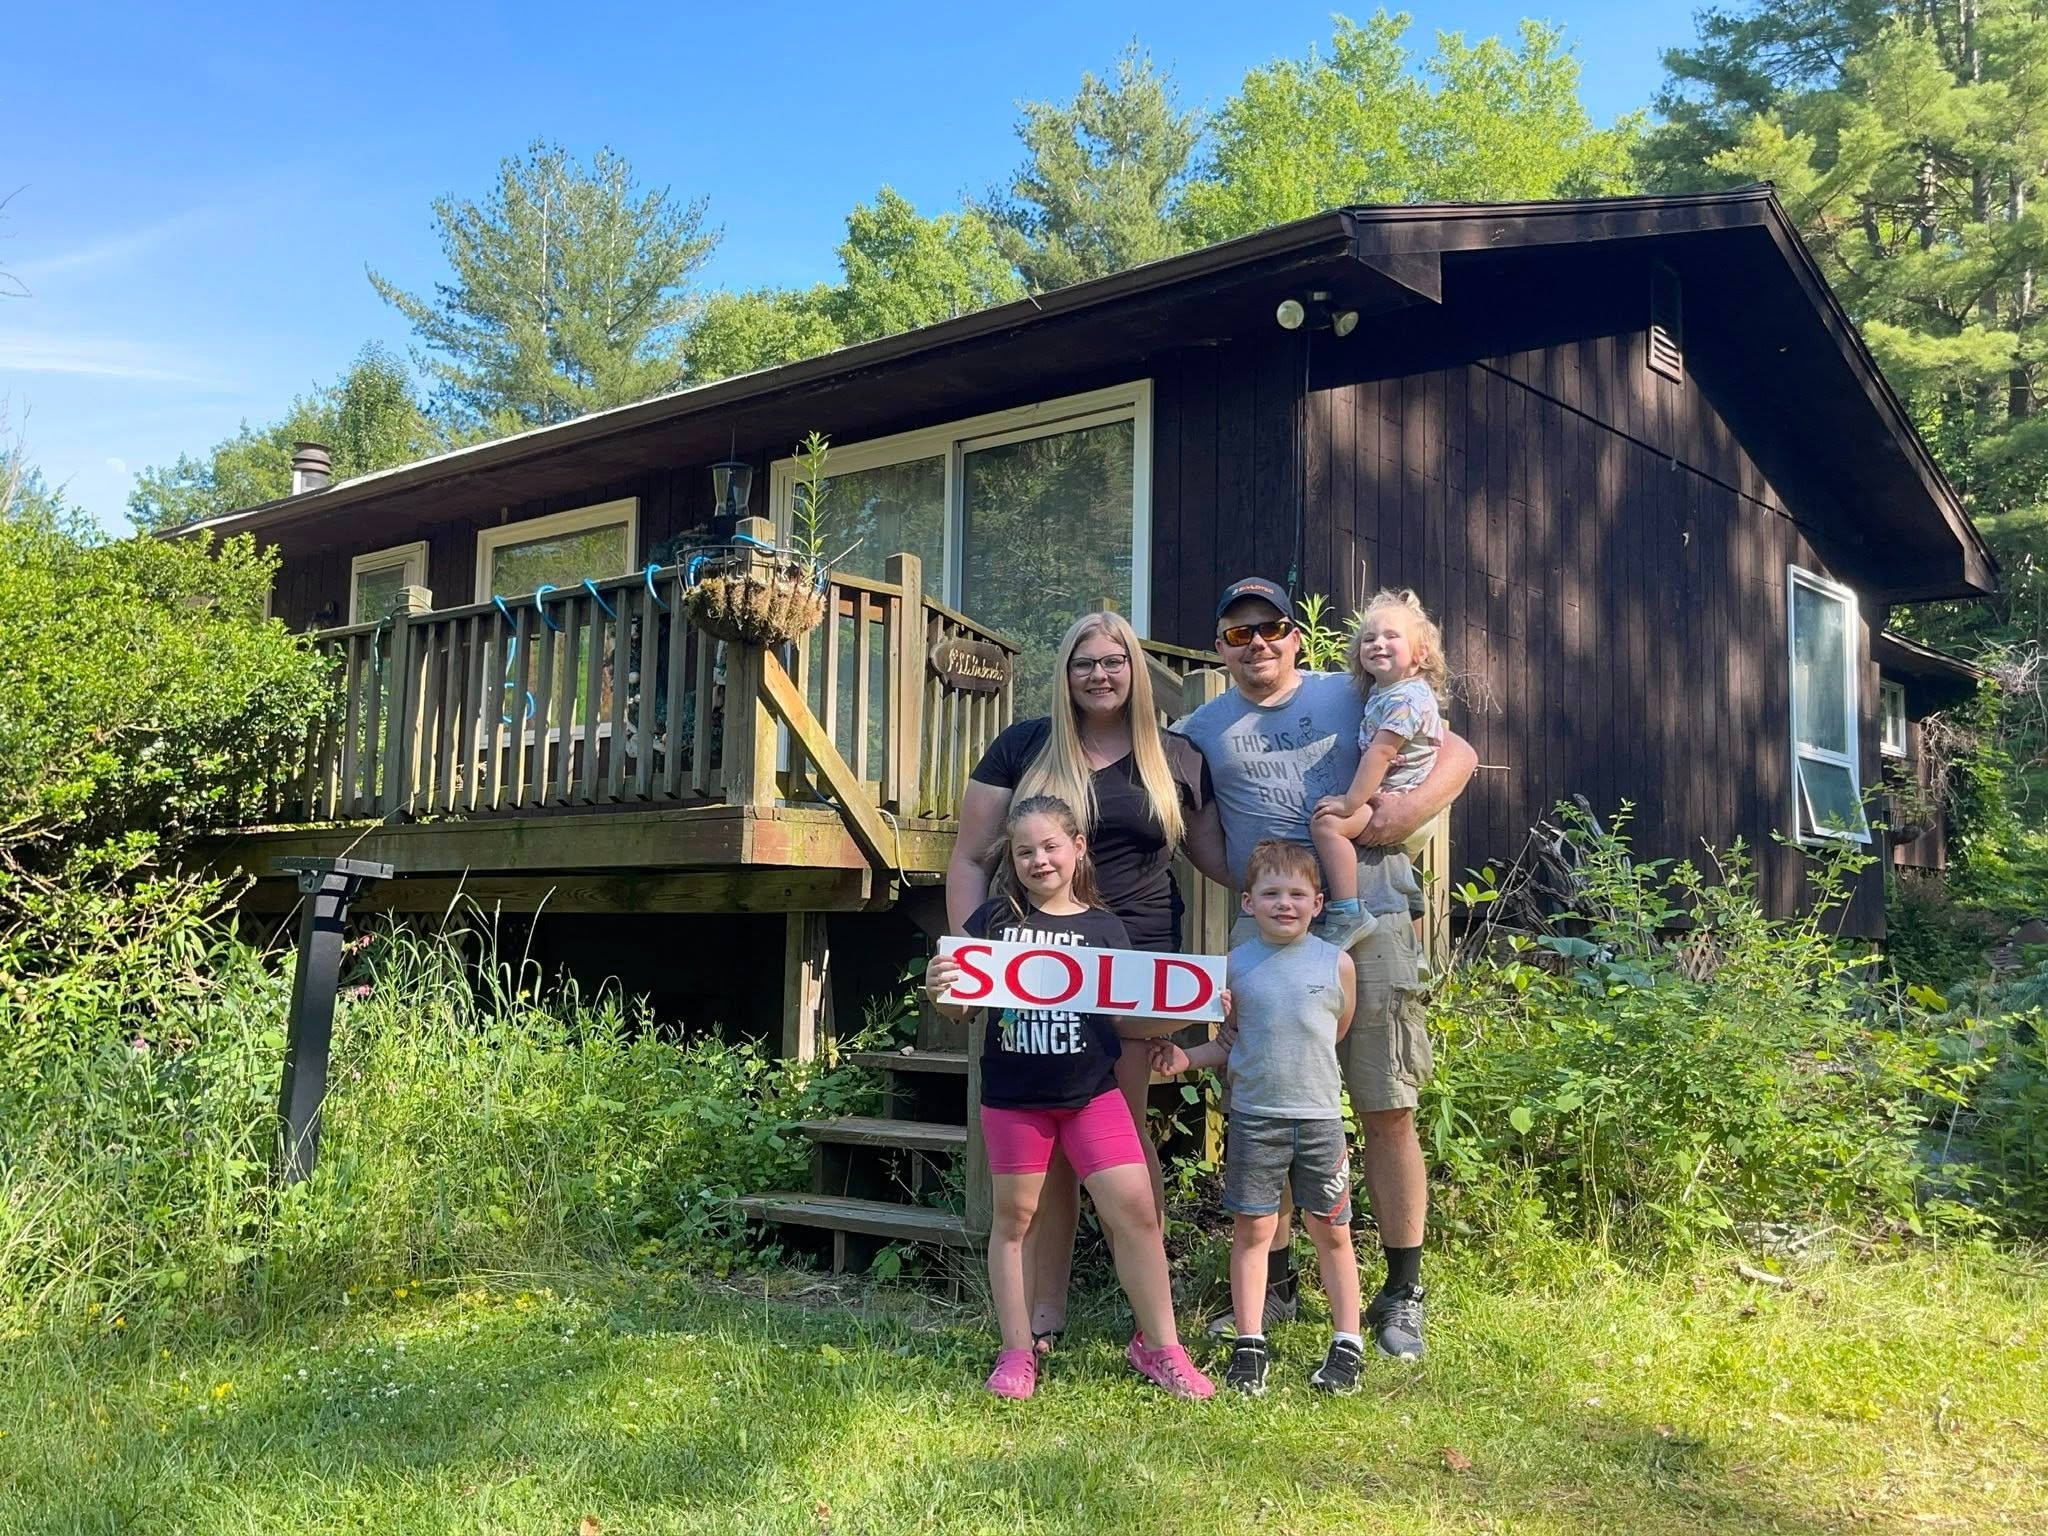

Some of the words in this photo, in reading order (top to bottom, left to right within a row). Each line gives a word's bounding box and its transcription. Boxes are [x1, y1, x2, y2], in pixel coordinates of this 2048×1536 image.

[1232, 734, 1273, 753] THIS
[1274, 732, 1294, 751] IS
[1243, 761, 1288, 779] HOW
[1293, 762, 1302, 781] I
[950, 944, 1214, 1013] SOLD
[1001, 1021, 1083, 1054] DANCE
[1322, 1158, 1350, 1199] NAS
